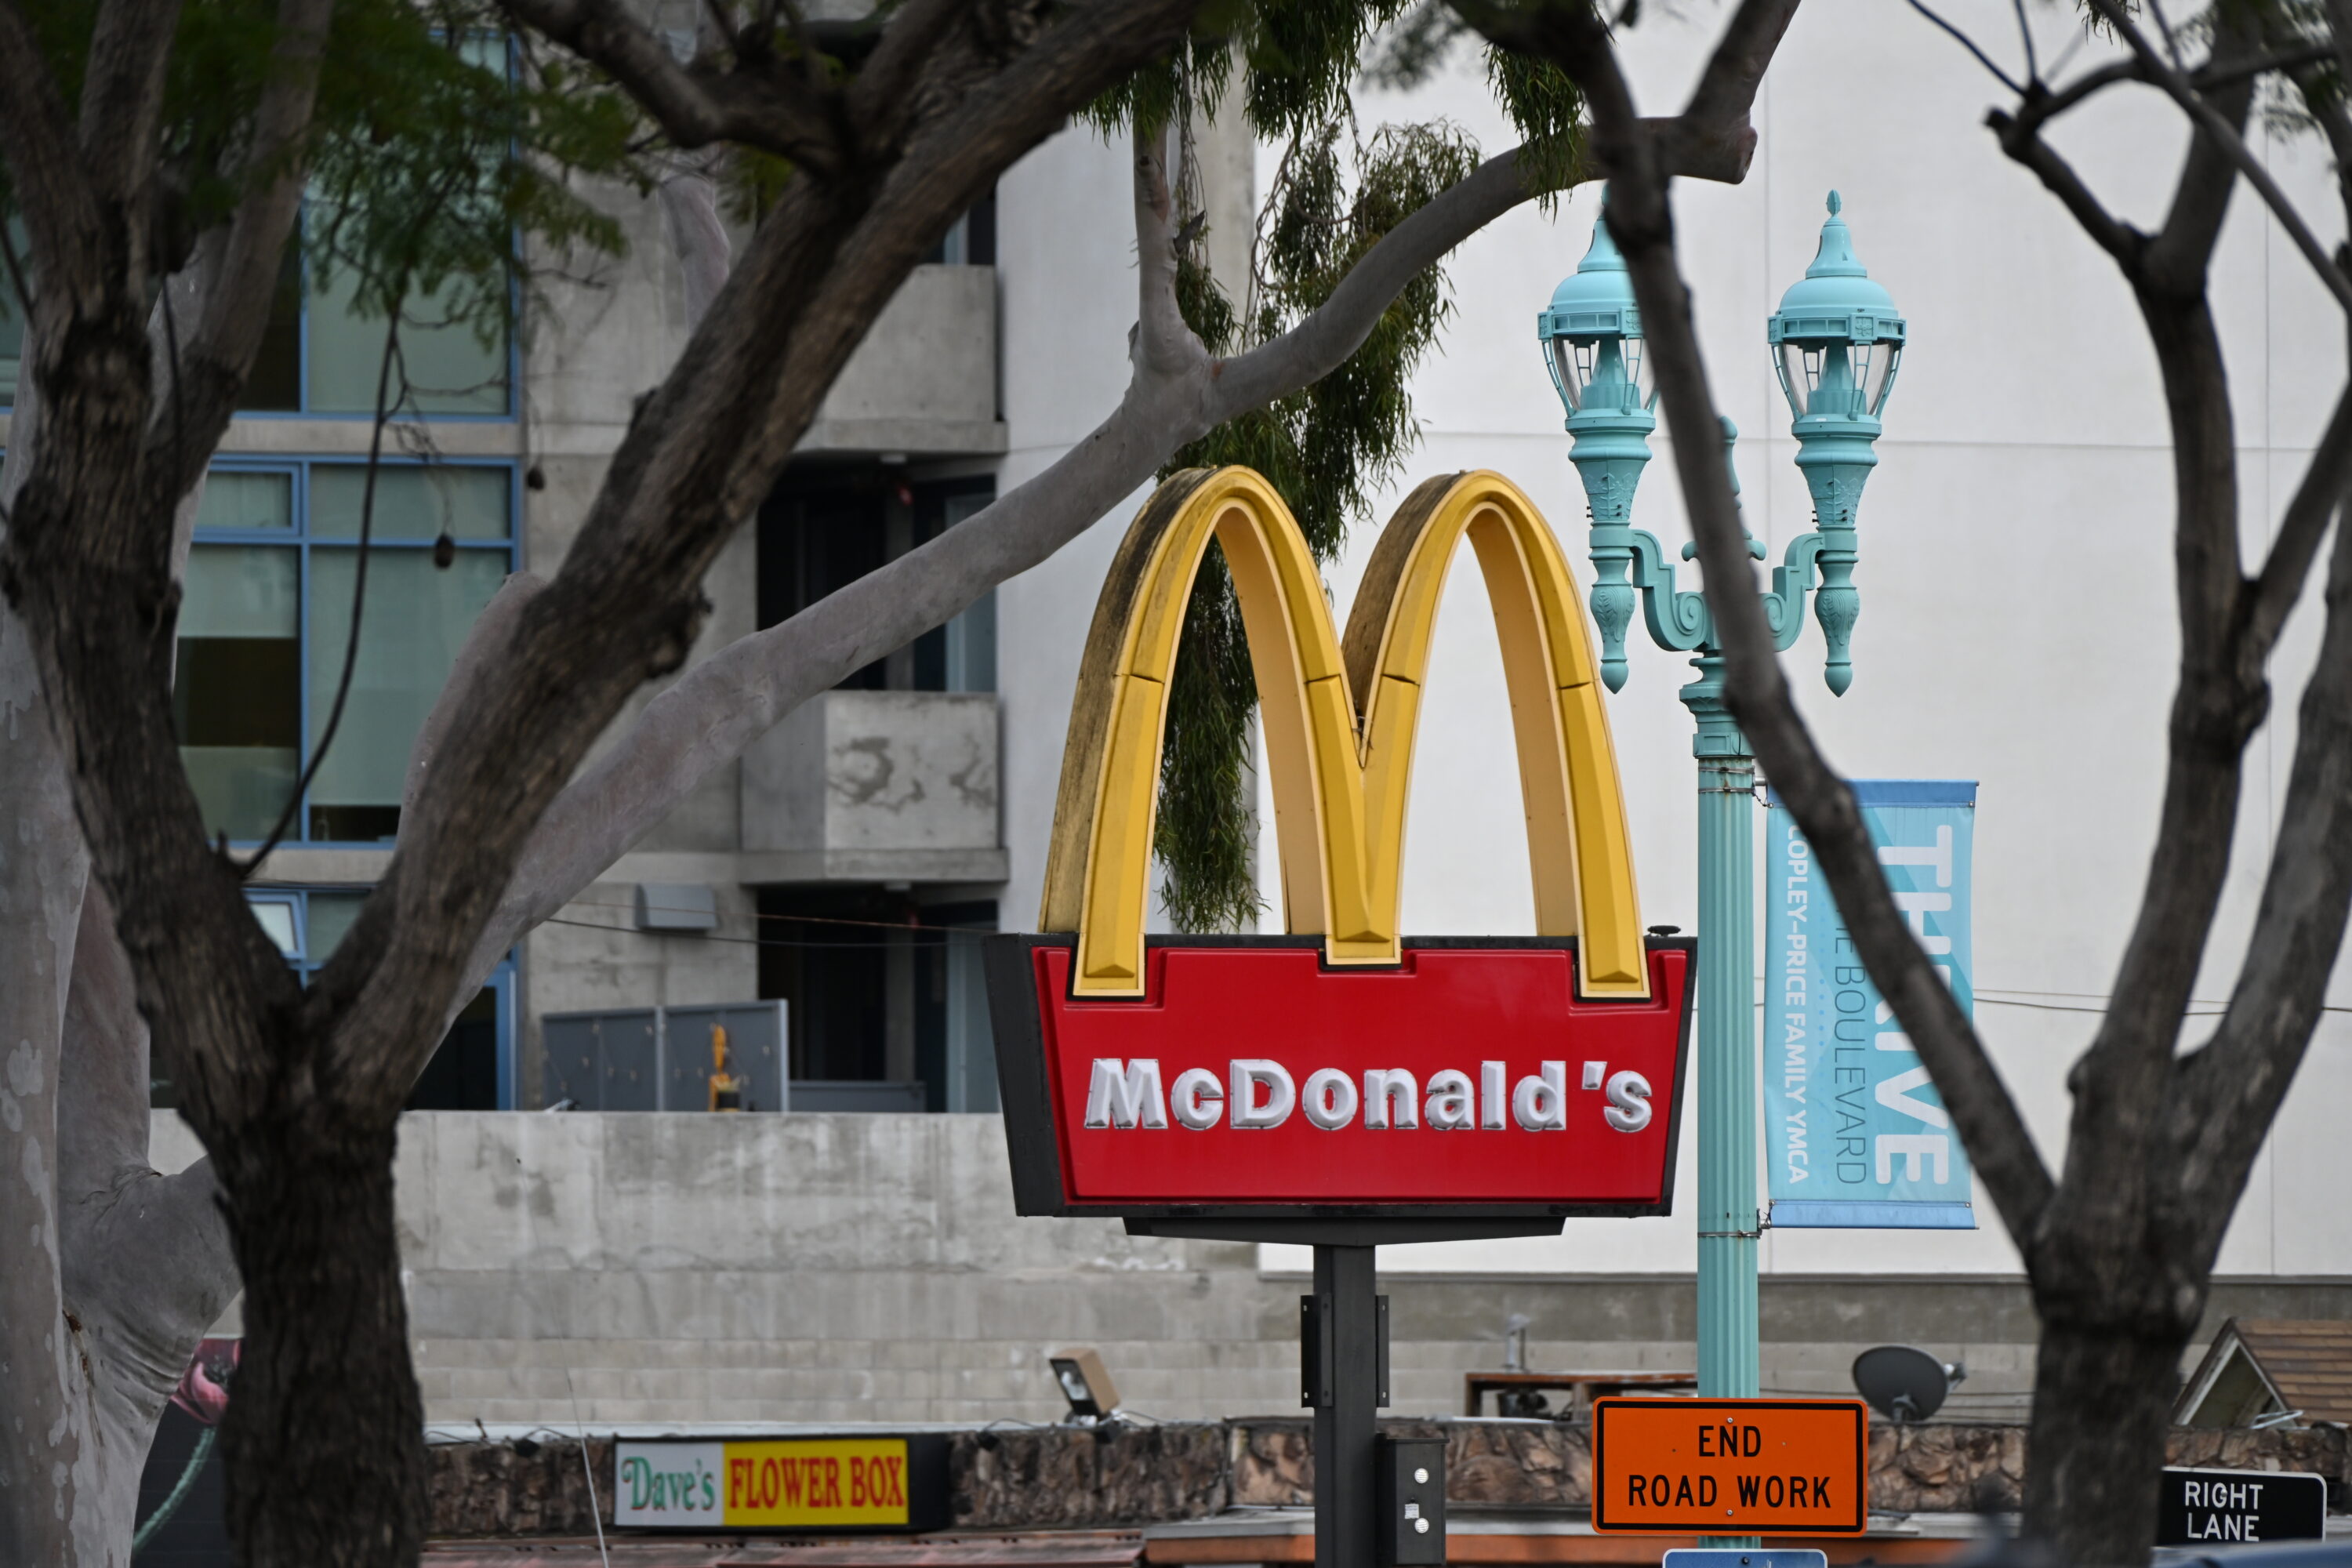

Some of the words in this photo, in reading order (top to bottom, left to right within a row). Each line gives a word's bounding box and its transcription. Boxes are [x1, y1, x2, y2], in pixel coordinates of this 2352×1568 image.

[1875, 825, 1952, 1185] THVE
[1784, 1013, 1806, 1104] FAMILY
[1834, 966, 1867, 1184] BOULEVARD
[1083, 1058, 1653, 1133] McDonald's
[1786, 1109, 1809, 1184] YMCA
[1698, 1425, 1762, 1457] END
[621, 1456, 715, 1511] Dave's
[729, 1456, 843, 1509] FLOWER
[849, 1455, 905, 1508] BOX
[1628, 1474, 1718, 1507] ROAD
[1737, 1475, 1831, 1508] WORK
[2184, 1480, 2264, 1510] RIGHT
[2187, 1512, 2260, 1542] LANE
